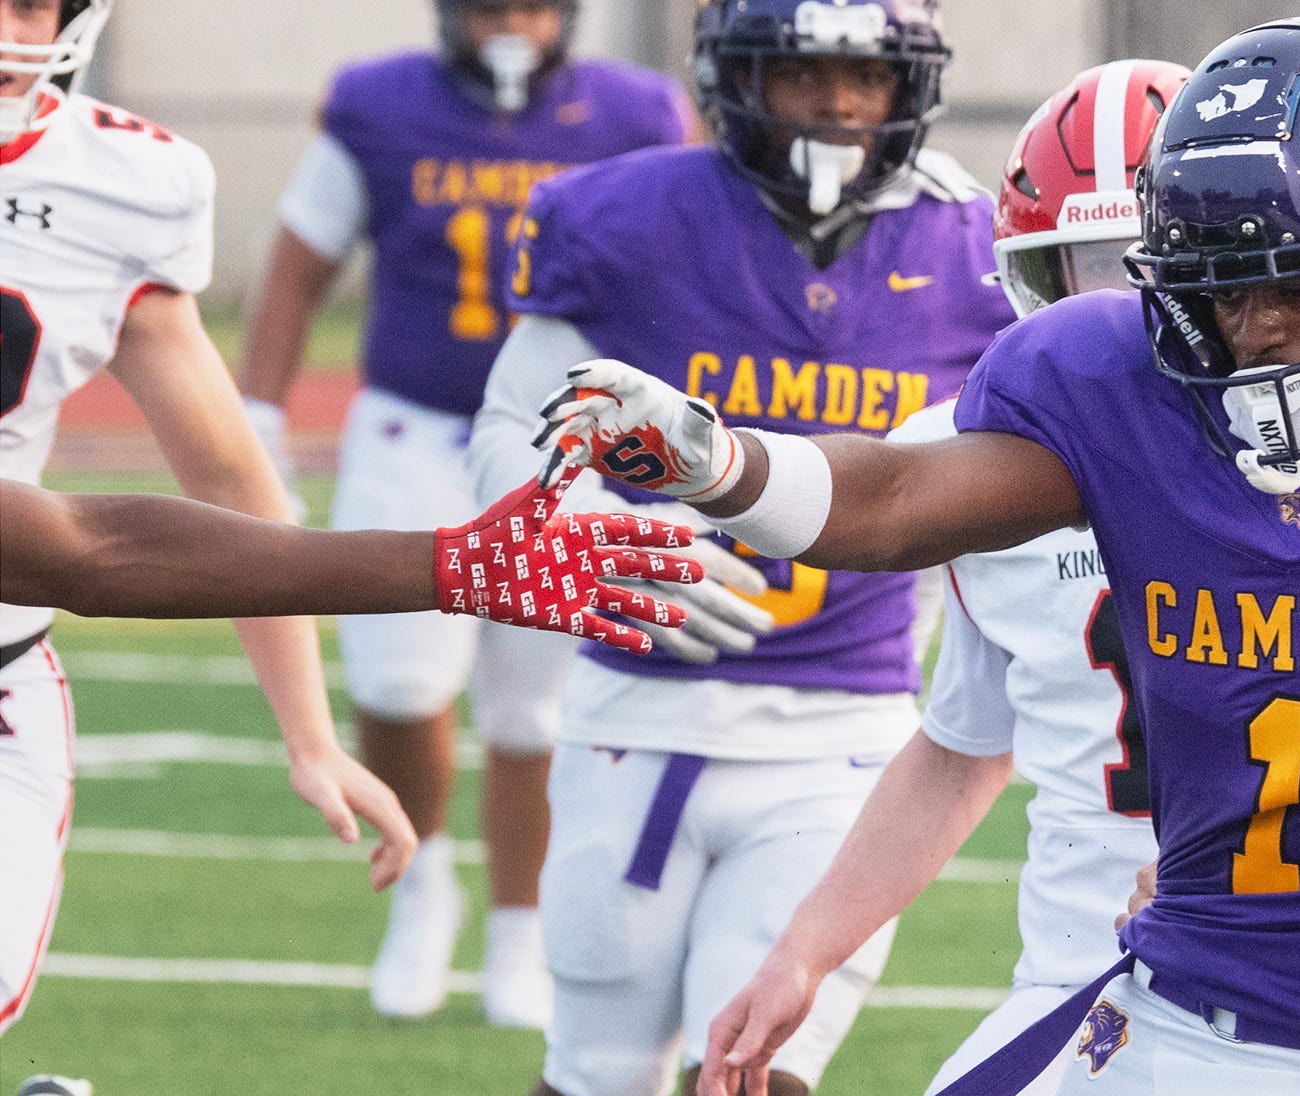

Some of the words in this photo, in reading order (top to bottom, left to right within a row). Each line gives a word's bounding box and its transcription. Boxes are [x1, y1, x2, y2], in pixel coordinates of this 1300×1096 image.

[1066, 200, 1141, 223] Riddel
[1161, 291, 1205, 348] iddell
[600, 434, 668, 484] S
[1257, 419, 1298, 474] NXTRD
